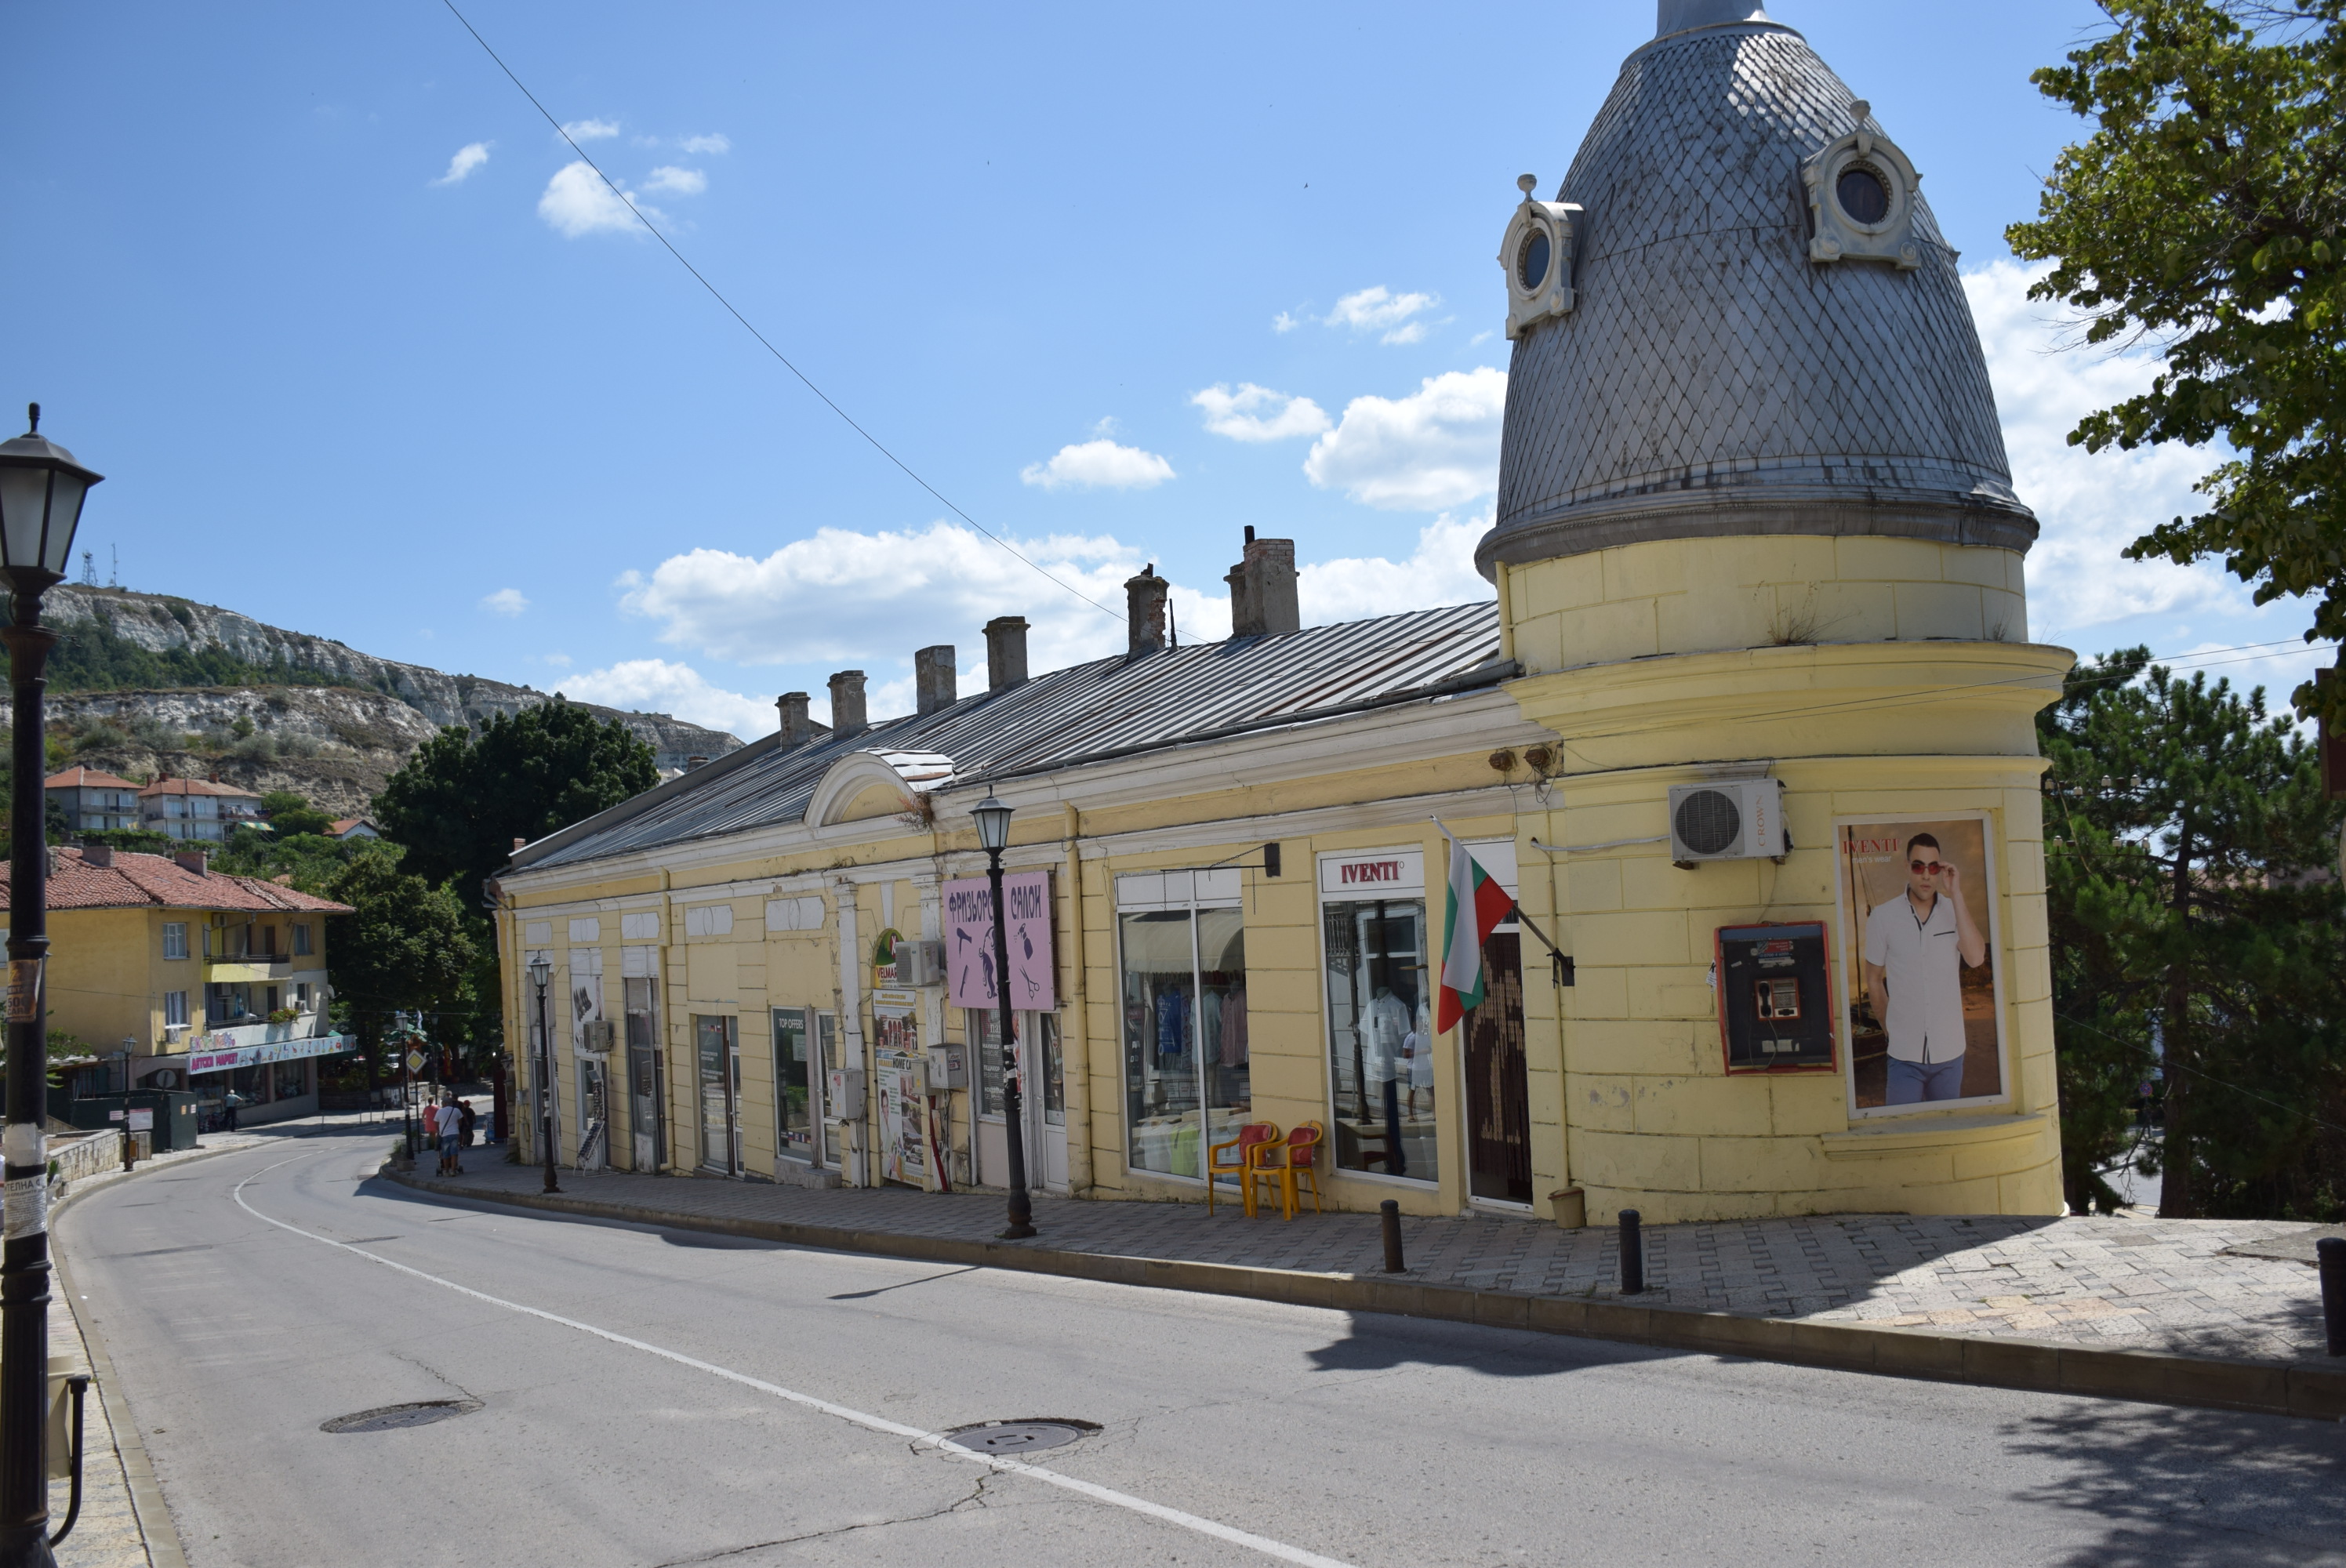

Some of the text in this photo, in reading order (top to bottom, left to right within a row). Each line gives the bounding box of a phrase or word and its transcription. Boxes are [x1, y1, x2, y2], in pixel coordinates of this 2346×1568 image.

[1756, 794, 1766, 848] CROWN
[1843, 838, 1899, 855] IVENTI
[1340, 861, 1400, 884] IVENTI
[949, 884, 1041, 923] ФРИЗЬОРС САЛОН
[788, 1018, 804, 1029] OFFERS
[216, 1052, 238, 1066] МАРКЕТ
[892, 1058, 905, 1069] HOME
